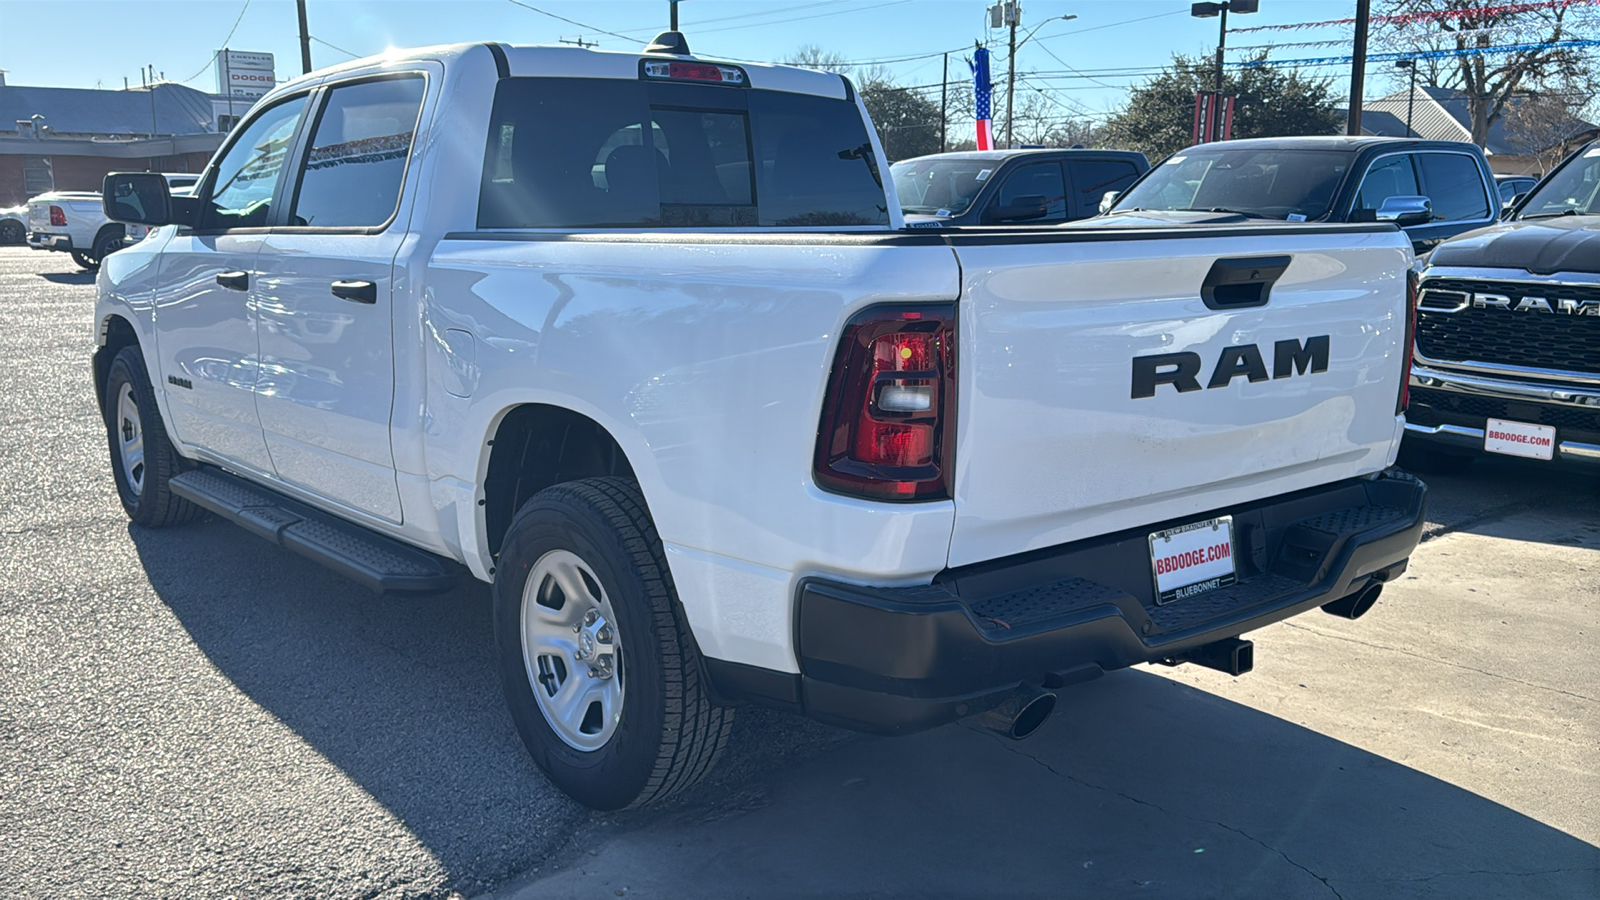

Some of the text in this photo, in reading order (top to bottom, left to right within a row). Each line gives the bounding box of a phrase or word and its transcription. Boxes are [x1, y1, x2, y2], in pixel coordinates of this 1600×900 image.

[231, 74, 274, 82] DODGE
[1473, 292, 1600, 316] RAM
[1131, 334, 1330, 399] RAM
[1488, 430, 1551, 447] BBDODGE.COM
[1165, 527, 1181, 536] NEW
[1156, 542, 1231, 575] BBDODGE.COM
[1175, 579, 1221, 599] BLUEBONNET
